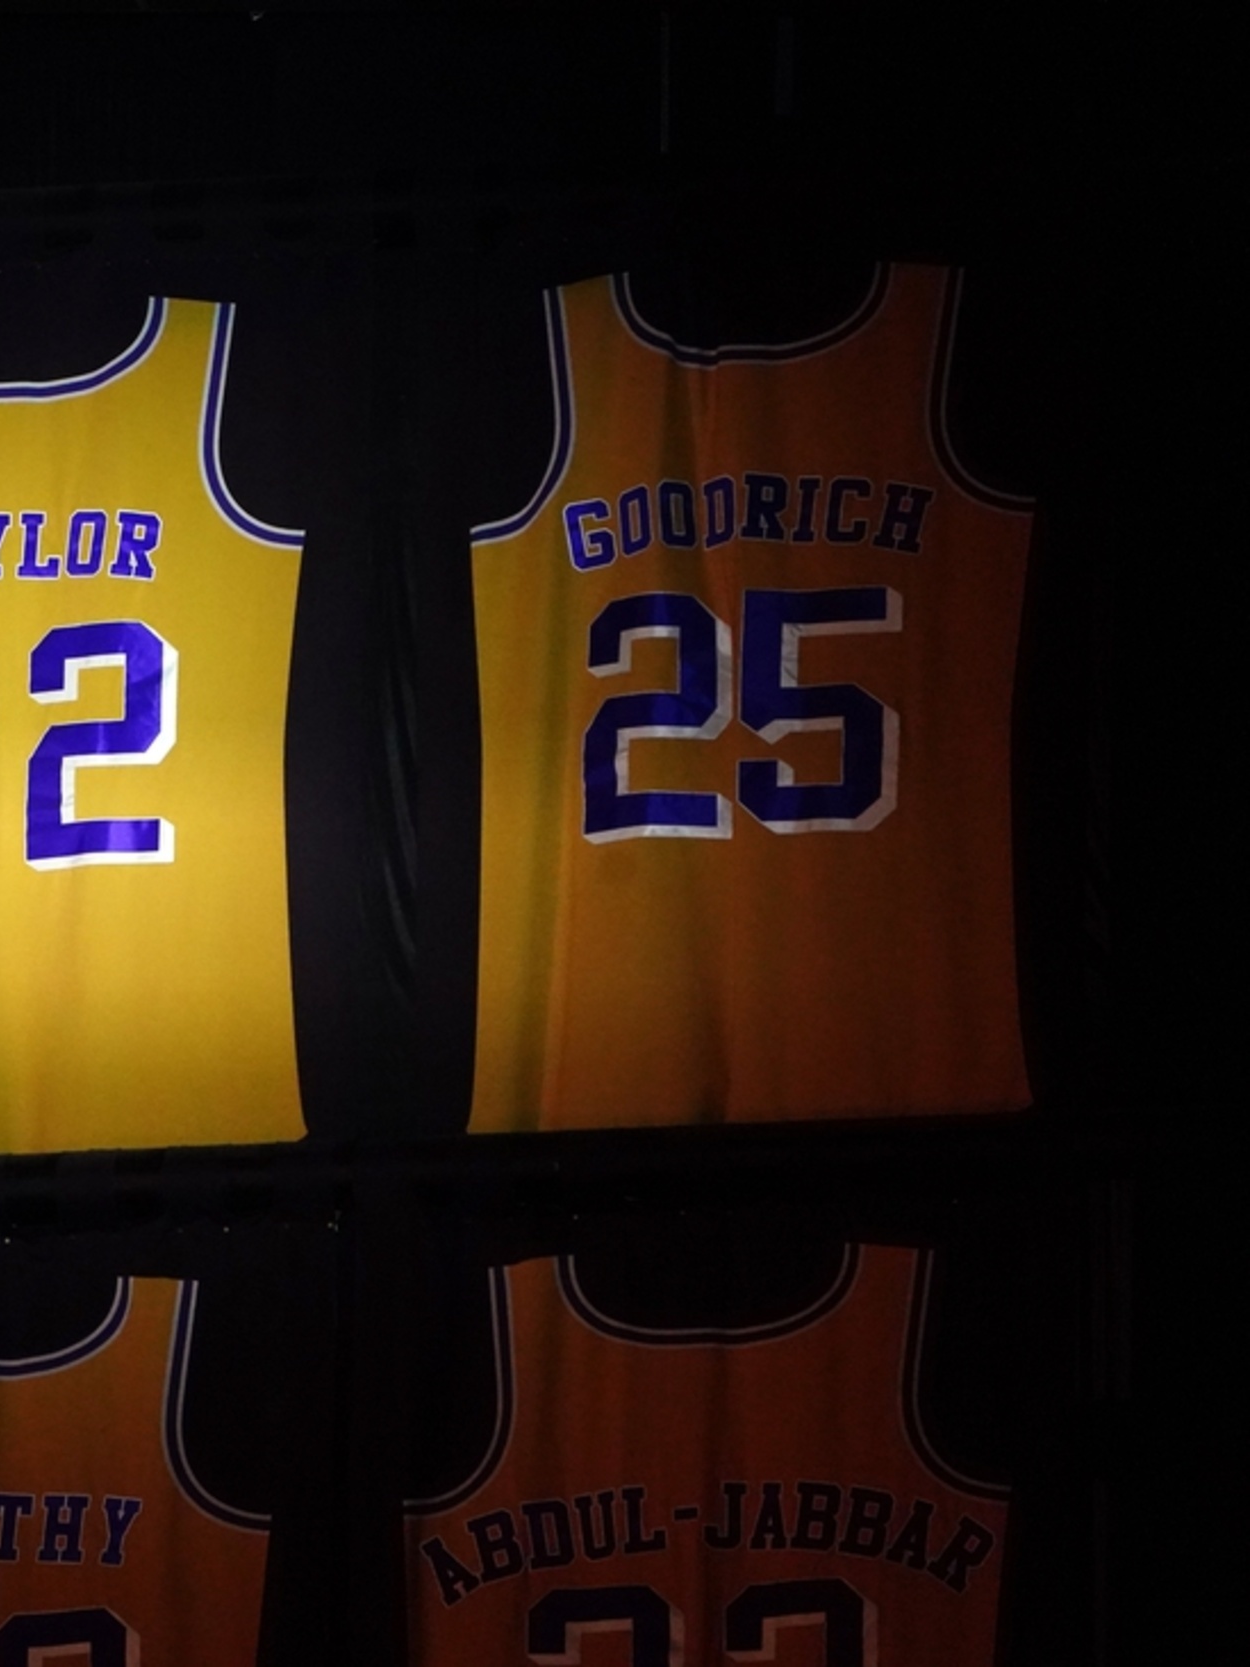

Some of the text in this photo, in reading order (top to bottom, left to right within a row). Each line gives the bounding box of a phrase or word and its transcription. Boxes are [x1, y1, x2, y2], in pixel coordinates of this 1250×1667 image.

[563, 470, 935, 572] GOODRICH
[581, 586, 903, 845] 25
[419, 1481, 996, 1607] ABDUL-JABBAR
